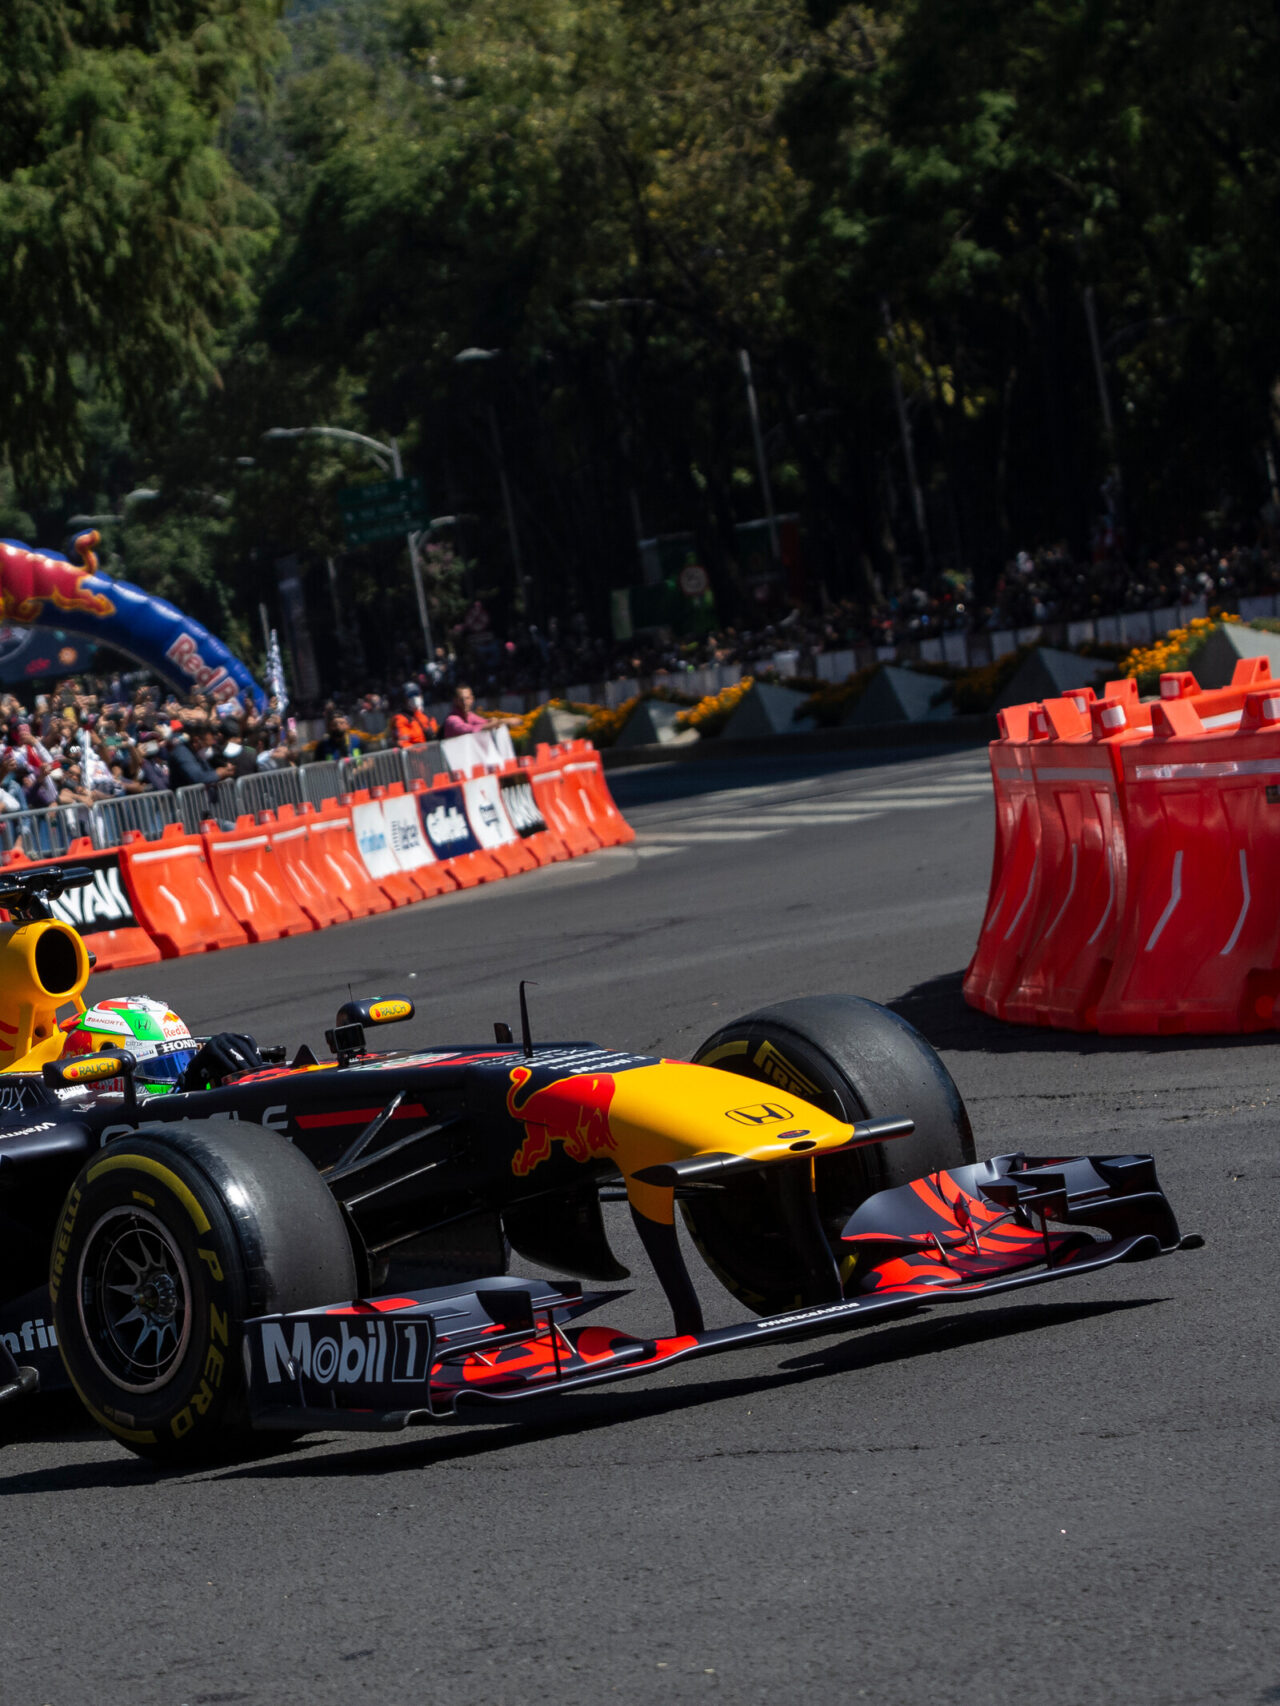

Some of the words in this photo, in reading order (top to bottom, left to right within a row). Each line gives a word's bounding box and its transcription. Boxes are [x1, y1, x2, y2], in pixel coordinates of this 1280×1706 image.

[380, 1004, 406, 1016] RAUCH
[161, 1039, 197, 1052] HOND
[78, 1060, 115, 1076] RAUCH
[197, 1248, 225, 1283] P
[261, 1320, 387, 1385] Mobil
[403, 1325, 416, 1378] 1
[170, 1303, 229, 1440] ZERO
